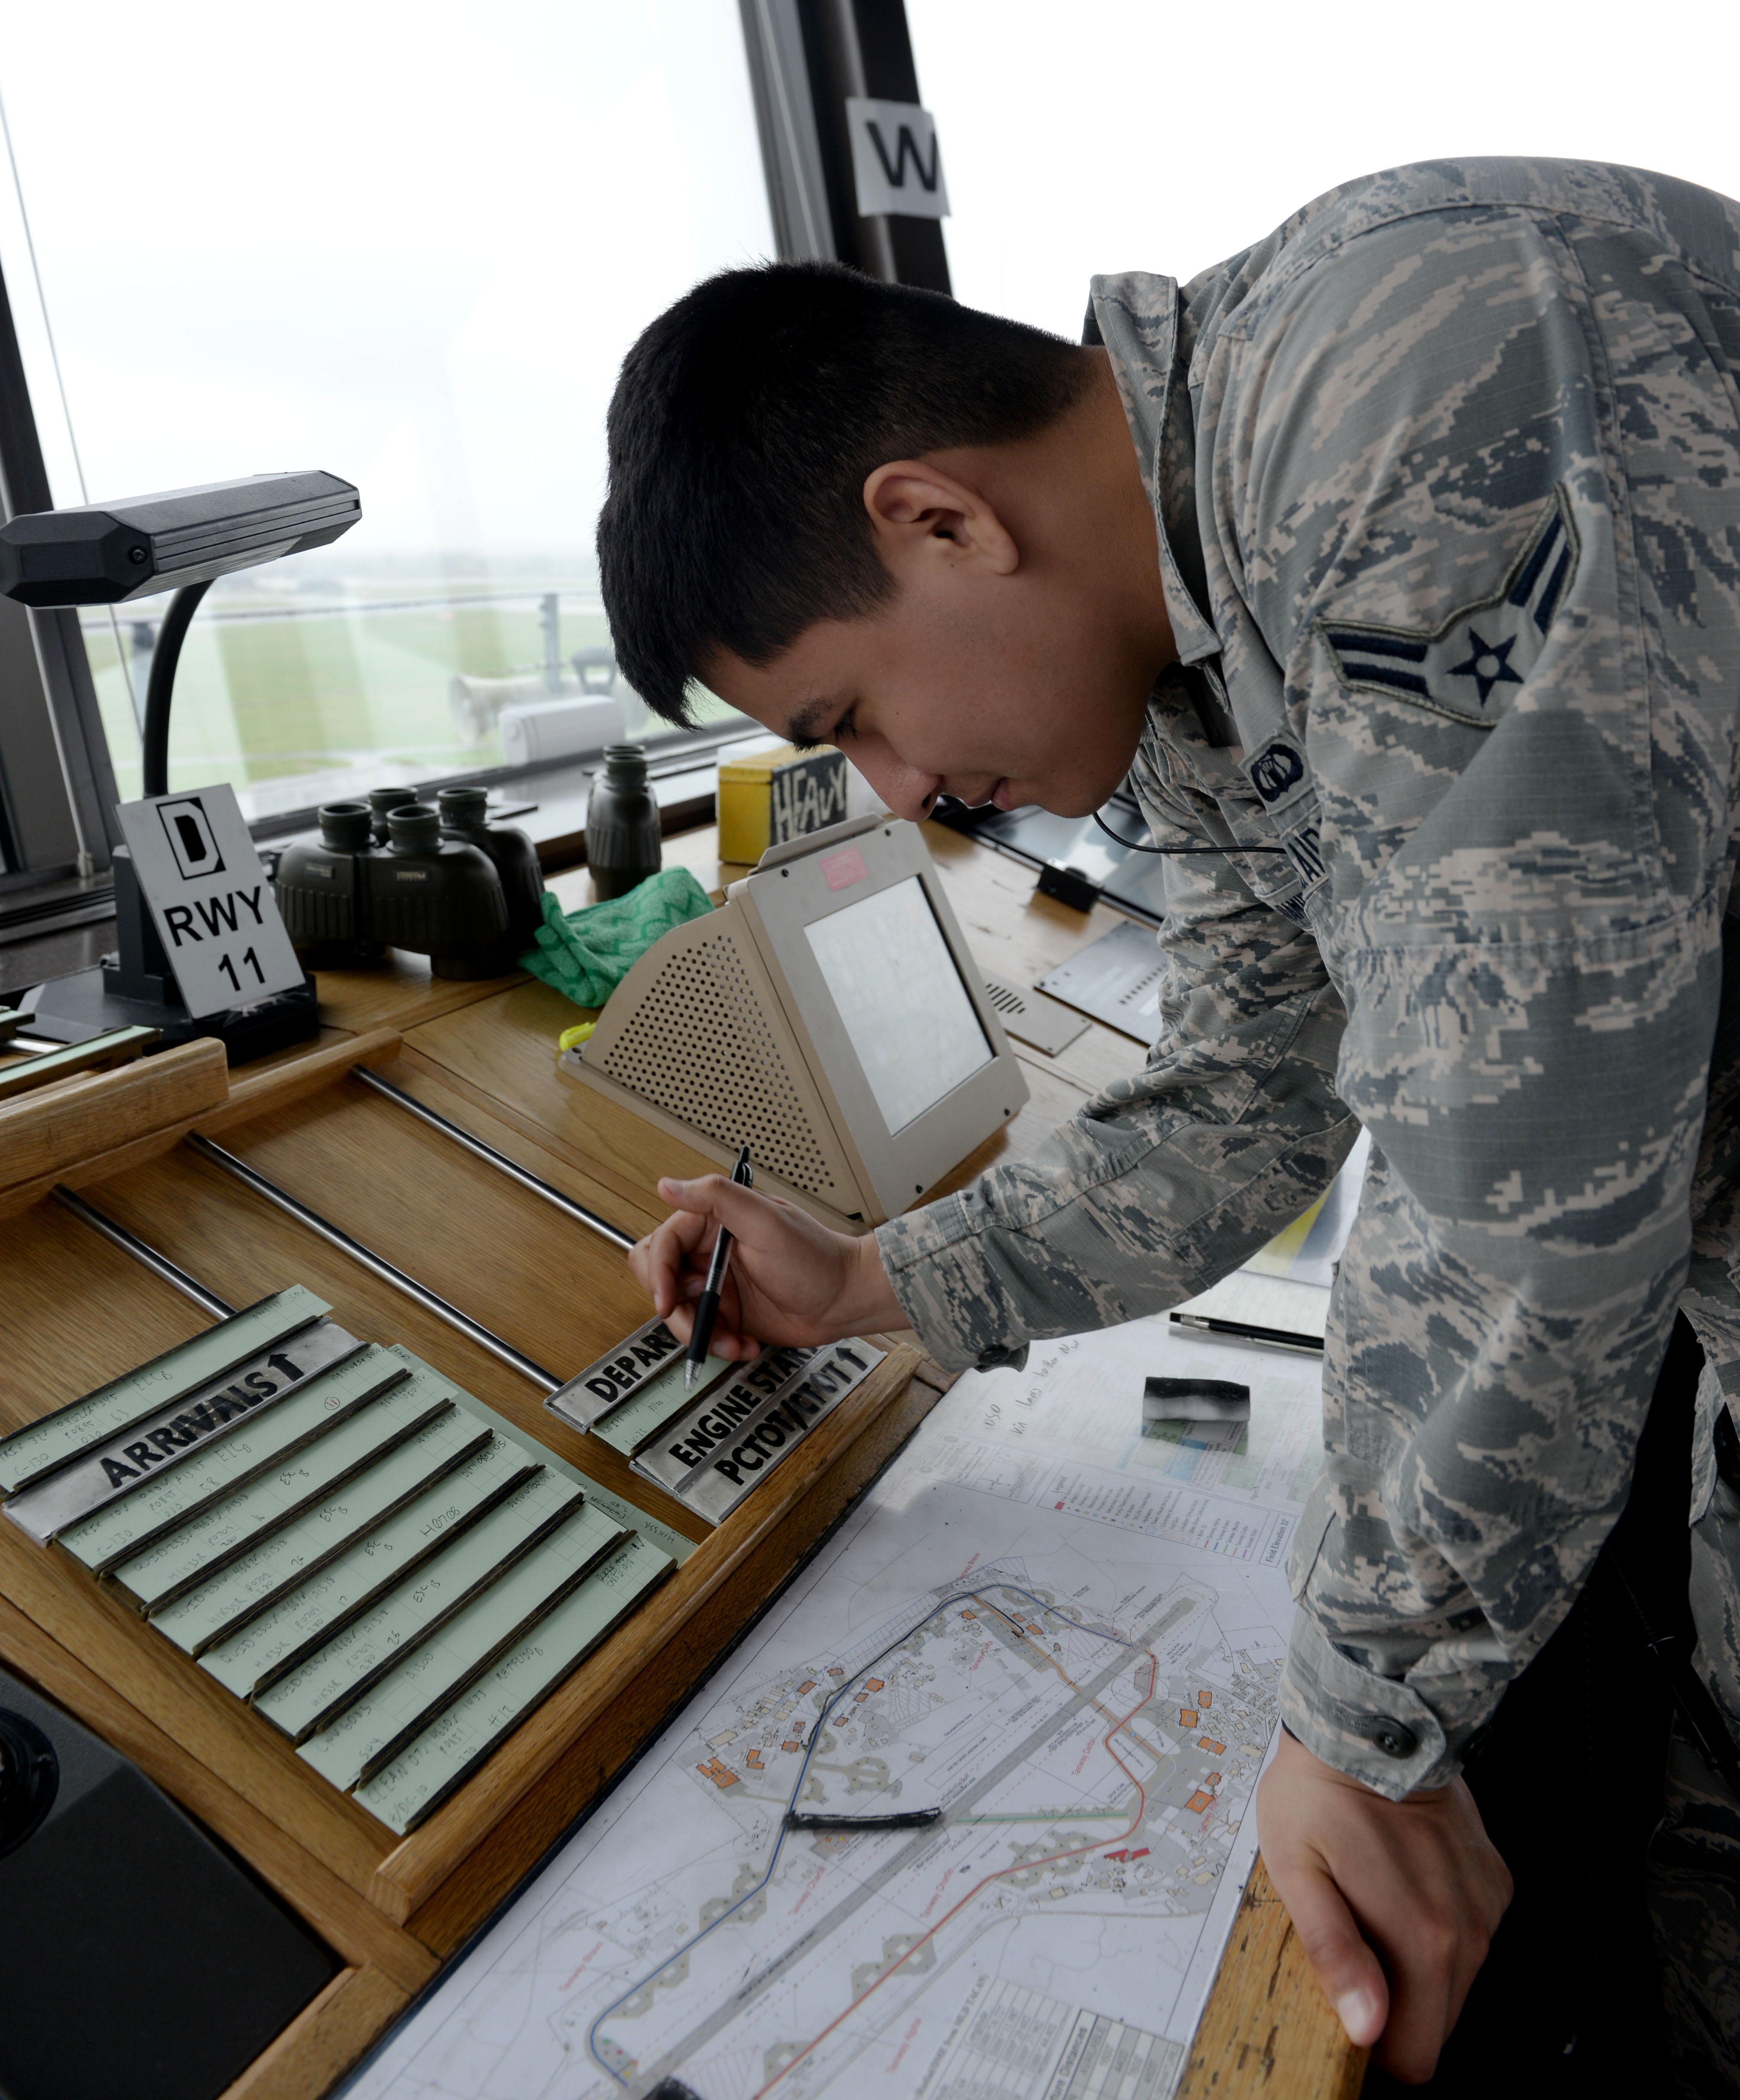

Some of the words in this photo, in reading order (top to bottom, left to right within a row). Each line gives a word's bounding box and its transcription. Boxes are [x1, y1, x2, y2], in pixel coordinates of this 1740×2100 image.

[865, 119, 937, 192] W
[773, 760, 845, 844] HEAVY
[163, 886, 263, 947] RWY
[218, 947, 266, 992] 11
[100, 1371, 278, 1489] ARRIVALS
[668, 1384, 762, 1468] ENGINE
[747, 1348, 818, 1394] STAR
[714, 1360, 853, 1486] PCTOT/CTOT
[11, 1452, 52, 1477] C-130
[108, 1407, 131, 1423] 63
[1052, 1475, 1068, 1494] Legend
[93, 1528, 136, 1557] C-130
[957, 1565, 972, 1581] Taxiway
[969, 1552, 980, 1568] Bravo
[1265, 1549, 1277, 1562] Field
[1271, 1526, 1287, 1549] Elevation
[969, 1651, 985, 1672] Taxiway
[982, 1640, 993, 1654] Delta
[1072, 1753, 1089, 1776] Taxiway
[1084, 1739, 1095, 1756] Delta
[788, 1889, 812, 1917] Taxiway
[808, 1866, 826, 1892] Charlie
[920, 1893, 942, 1919] Taxiway
[937, 1867, 954, 1896] Charlie
[559, 1964, 587, 1993] Taxiway
[583, 1941, 604, 1967] Bravo
[886, 2042, 909, 2074] Taxiway
[906, 2018, 922, 2047] Alpha
